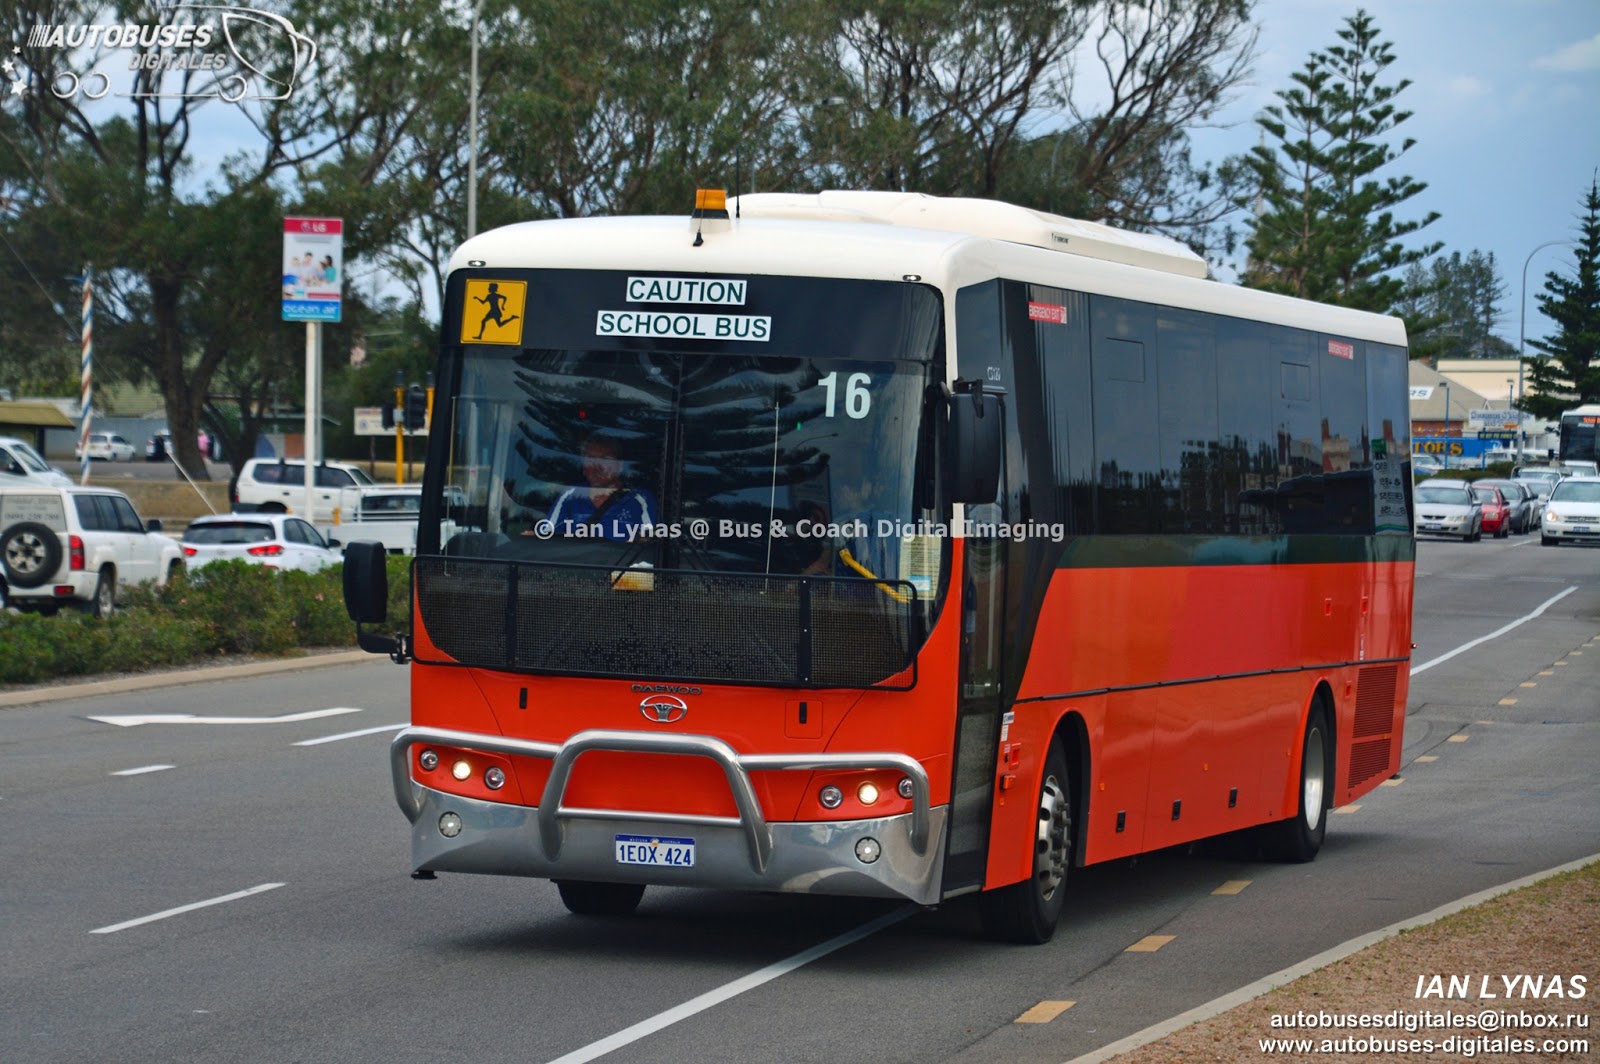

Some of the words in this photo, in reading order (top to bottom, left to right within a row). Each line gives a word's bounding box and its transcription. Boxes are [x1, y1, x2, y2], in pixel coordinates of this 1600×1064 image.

[312, 222, 327, 233] LG
[629, 279, 744, 303] CAUTION
[282, 303, 320, 314] ocean
[600, 313, 706, 336] SCHOOL
[715, 317, 768, 338] BUS
[817, 371, 872, 419] 16
[631, 684, 702, 695] DAEWOO
